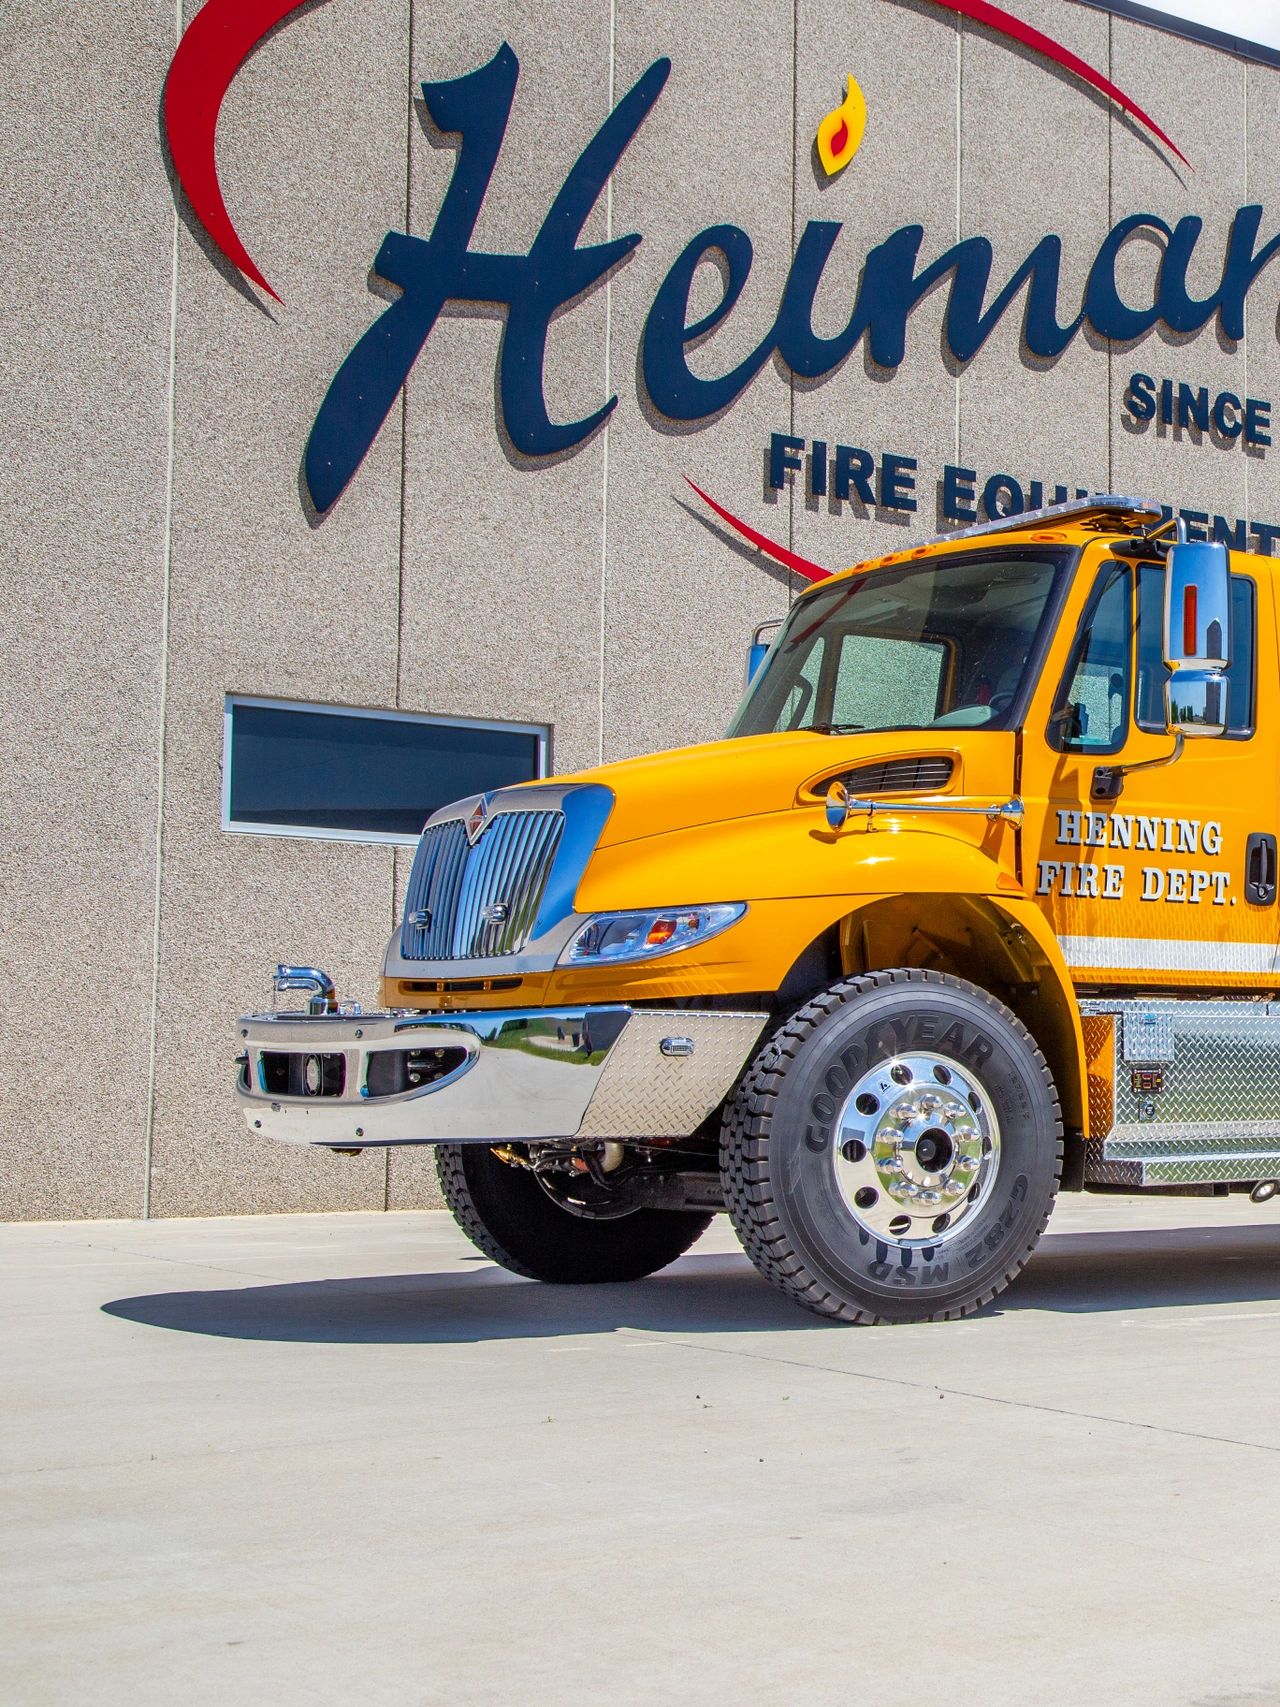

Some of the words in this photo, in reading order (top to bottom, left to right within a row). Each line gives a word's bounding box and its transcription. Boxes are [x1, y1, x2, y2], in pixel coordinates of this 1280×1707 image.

[1127, 372, 1272, 446] SINCE
[770, 432, 918, 511] FIRE
[1056, 809, 1223, 855] HENNING
[1036, 860, 1125, 899] FIRE
[1141, 867, 1236, 906] DEPT.
[804, 1014, 995, 1154] GOODYEAR
